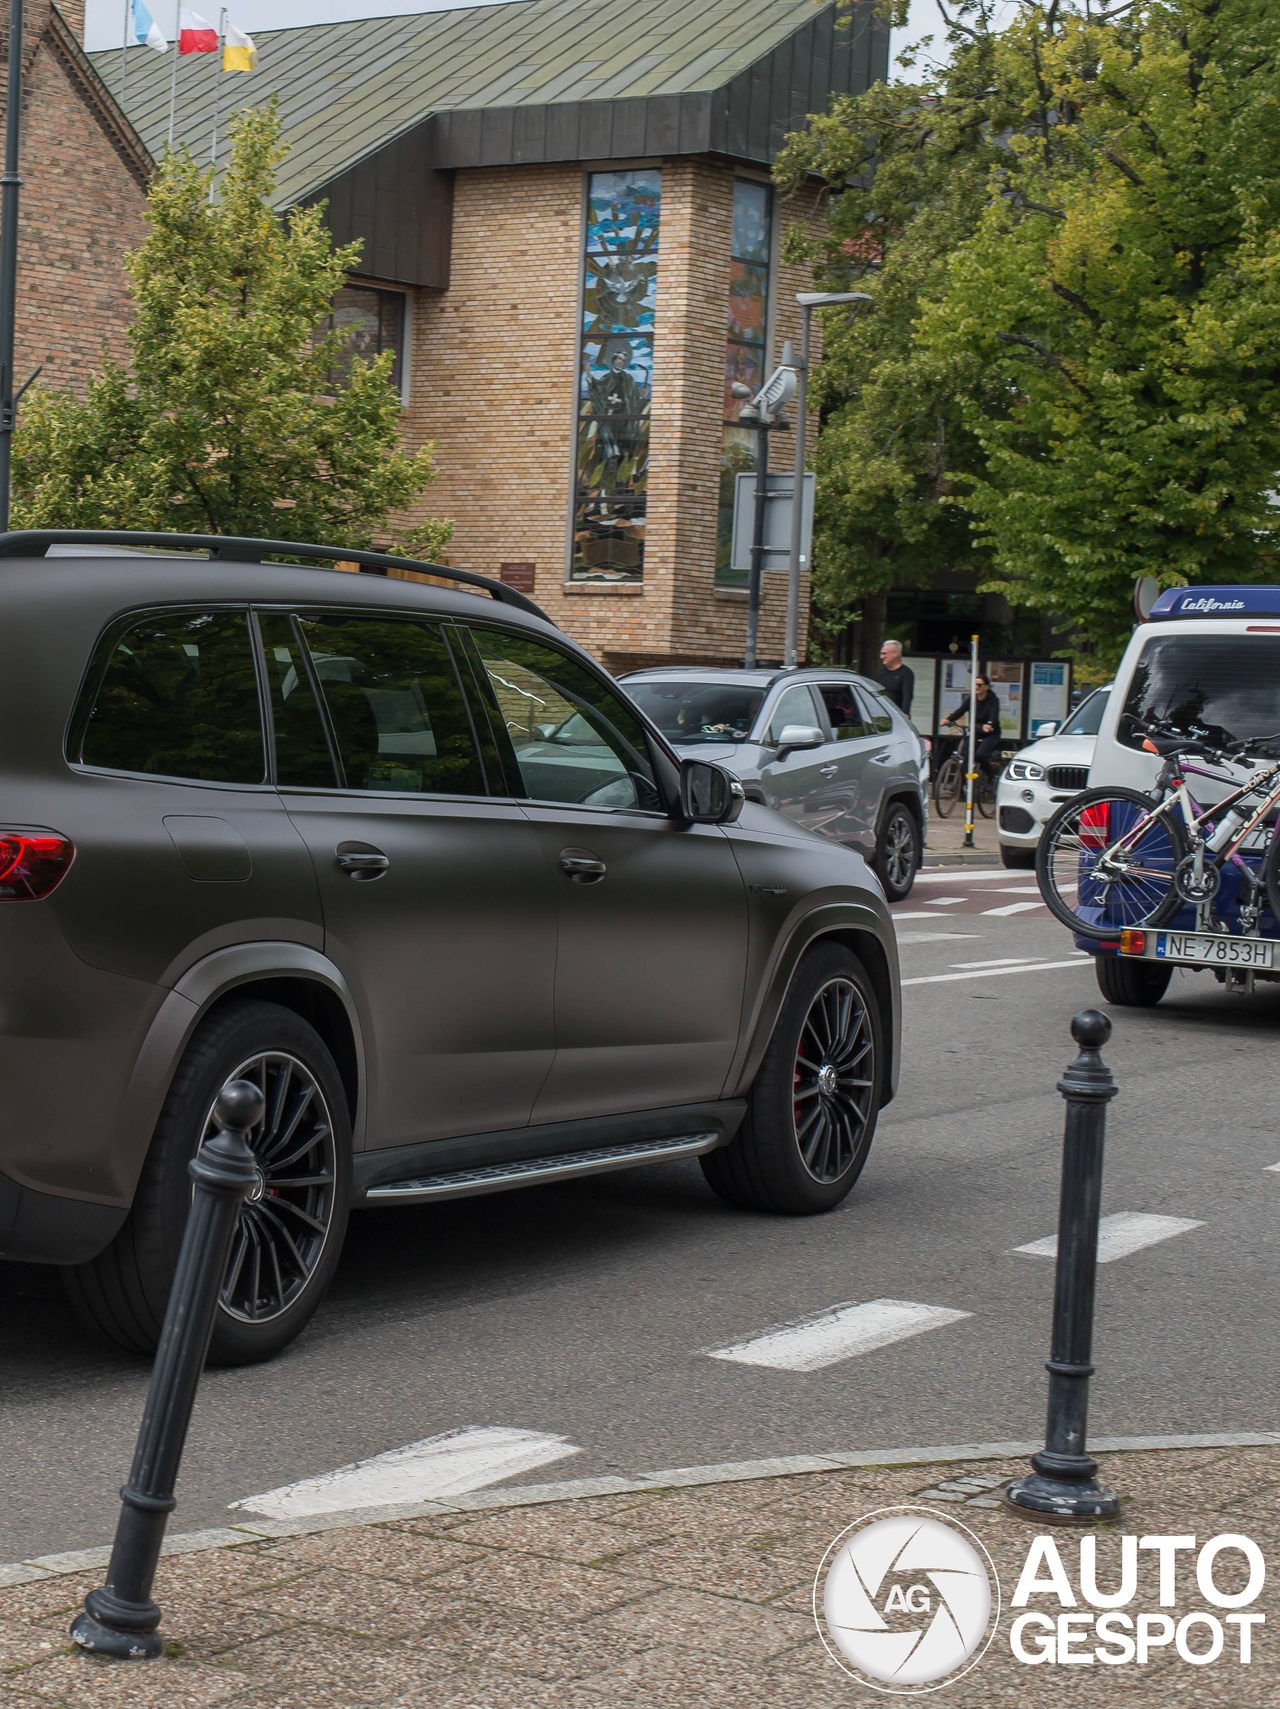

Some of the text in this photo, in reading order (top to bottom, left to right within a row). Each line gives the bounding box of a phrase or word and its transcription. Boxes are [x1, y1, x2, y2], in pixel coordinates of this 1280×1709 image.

[1181, 598, 1245, 612] California
[1170, 936, 1266, 964] NE 7853H
